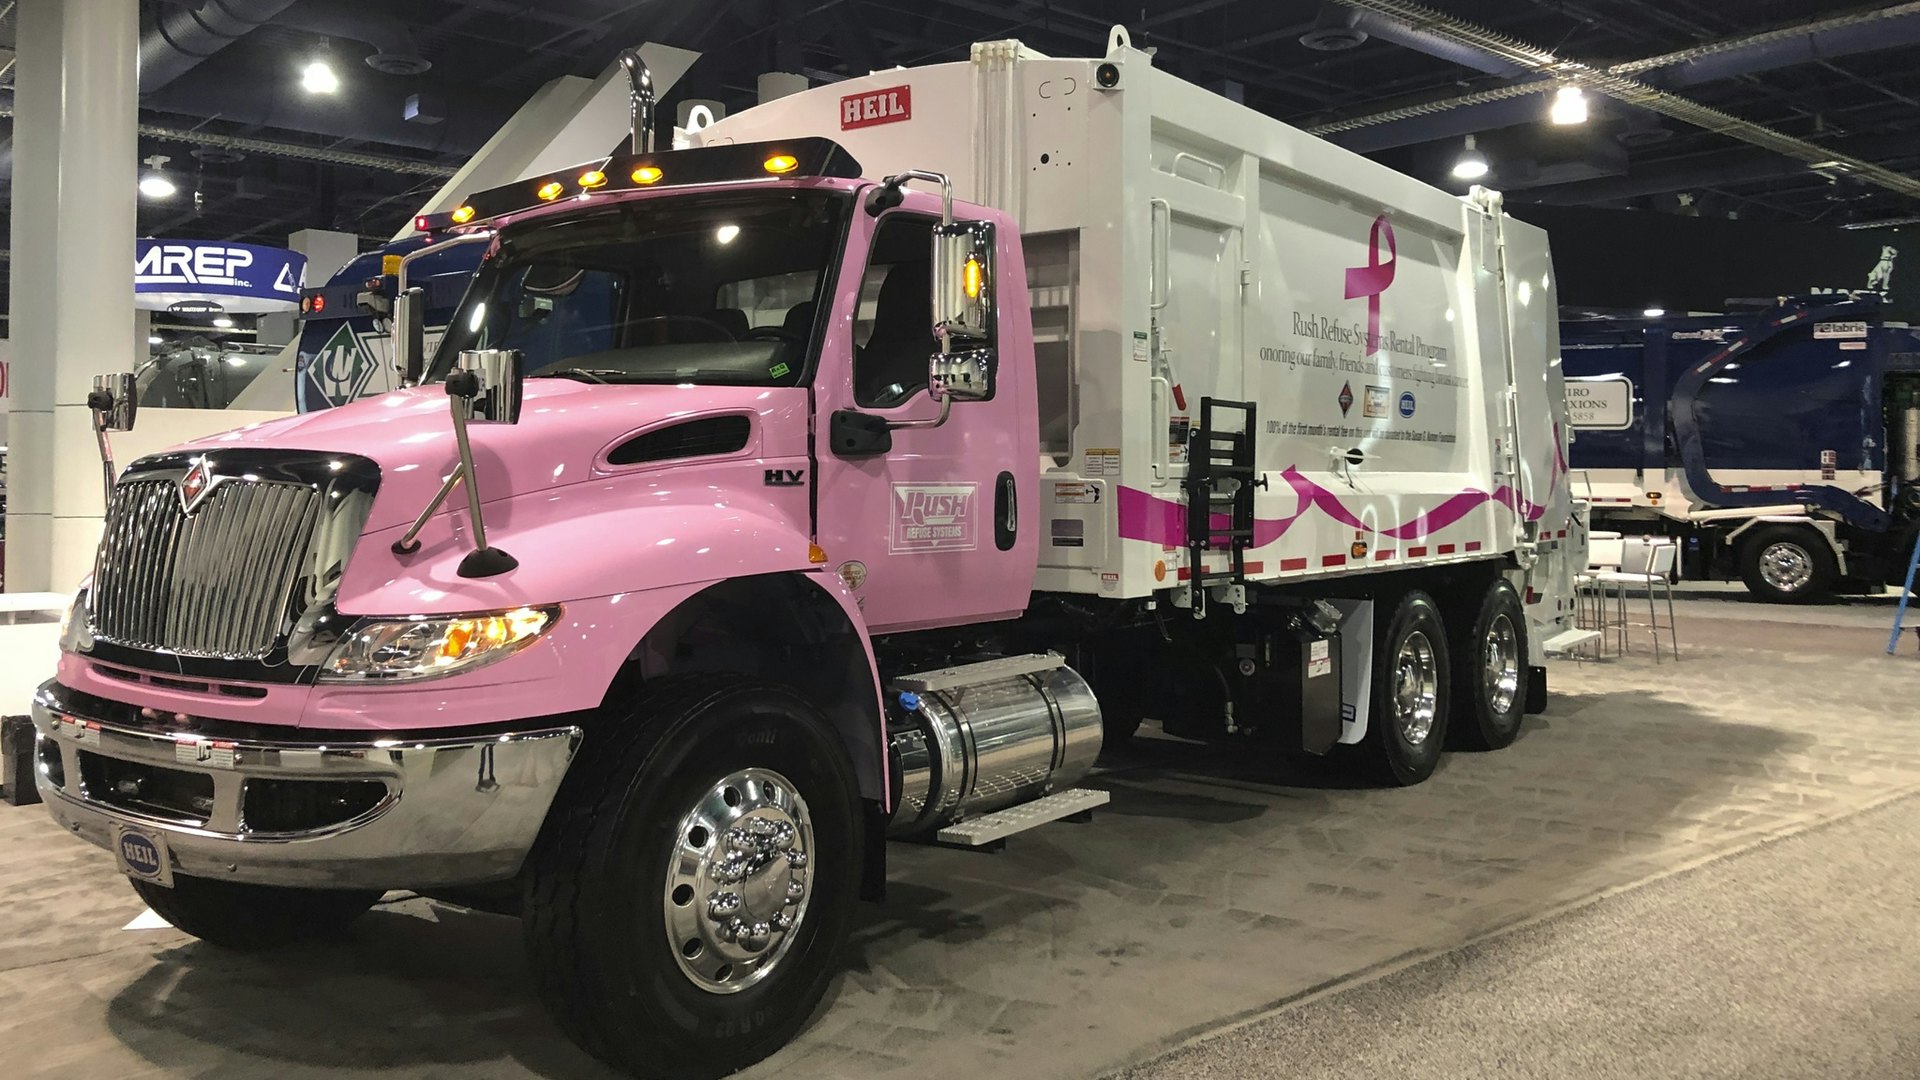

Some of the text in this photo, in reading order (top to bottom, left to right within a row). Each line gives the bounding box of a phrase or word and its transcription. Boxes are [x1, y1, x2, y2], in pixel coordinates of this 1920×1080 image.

[843, 92, 905, 123] HEIL
[1293, 311, 1319, 338] Rush
[1320, 316, 1352, 344] Refuse
[1390, 330, 1415, 355] Rental
[1416, 335, 1447, 362] Program
[1260, 345, 1296, 370] onoring
[1297, 351, 1312, 366] our
[1339, 352, 1364, 373] friends
[1401, 399, 1414, 411] HEIL
[1266, 420, 1281, 434] 100%
[764, 469, 805, 483] HV
[902, 491, 969, 526] RUSH
[907, 526, 962, 539] REFUSE SYSTEMS
[123, 842, 158, 867] HEIL
